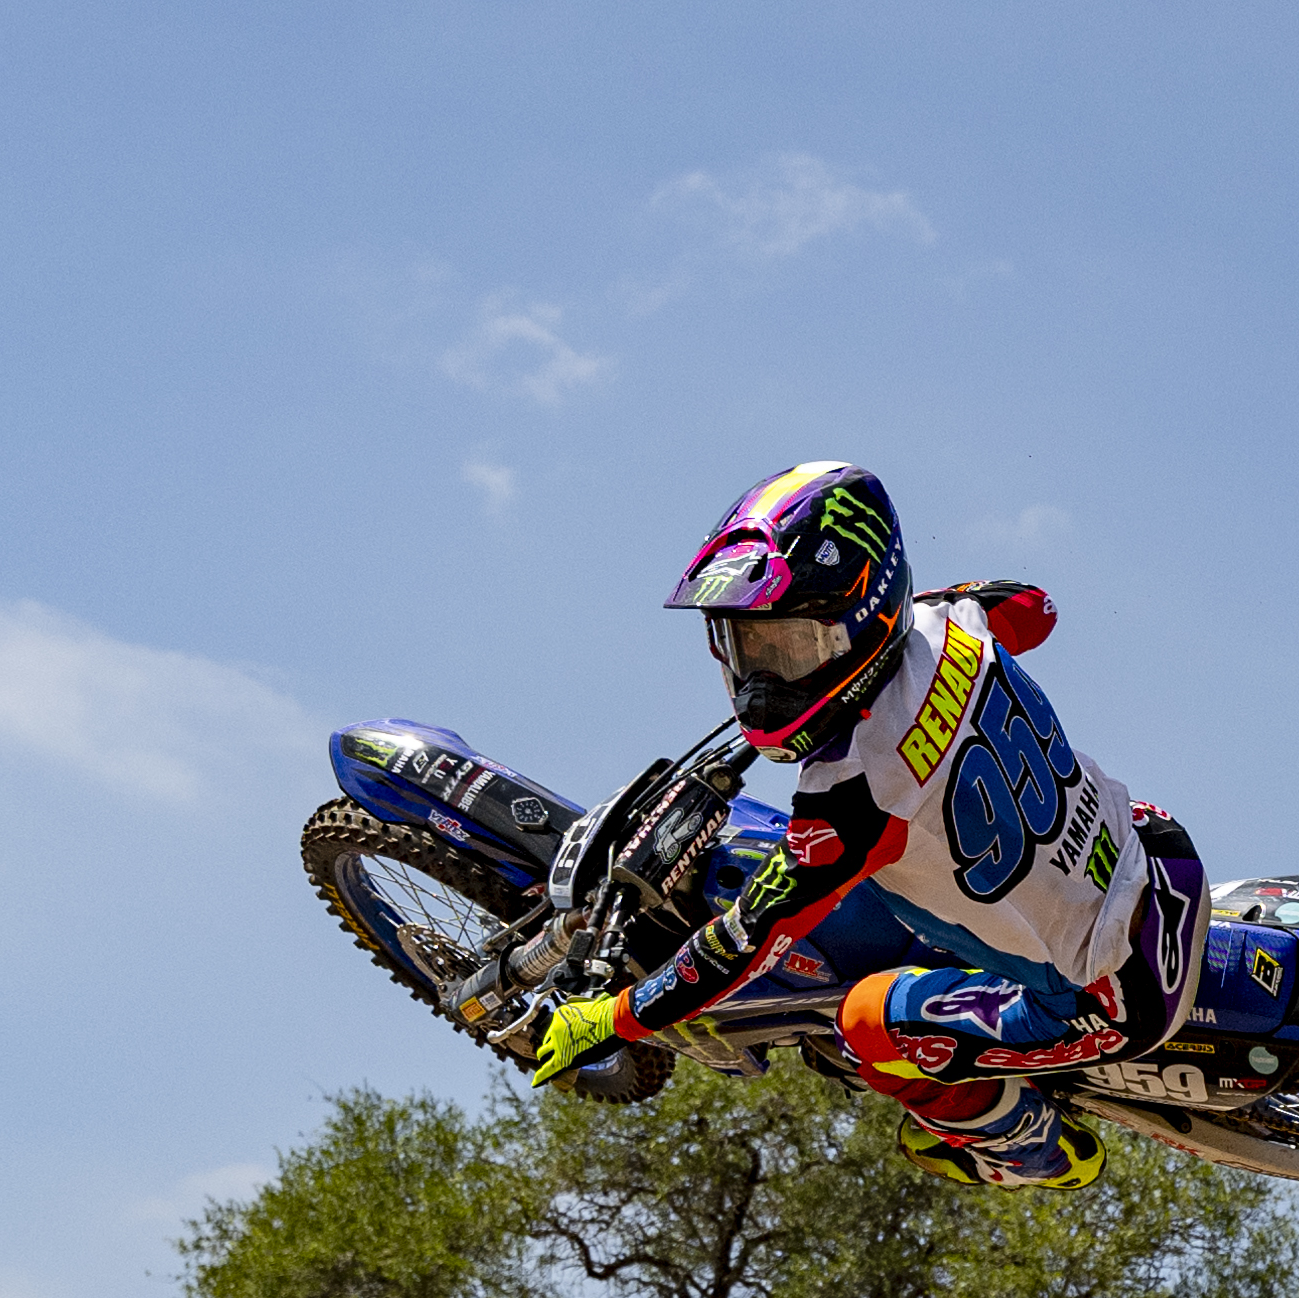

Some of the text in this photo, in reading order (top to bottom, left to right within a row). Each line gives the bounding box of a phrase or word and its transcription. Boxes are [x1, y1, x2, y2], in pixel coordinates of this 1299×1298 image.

[855, 537, 903, 623] OAKLEY
[899, 619, 984, 785] RENAUX
[457, 770, 497, 813] YAMALUBE
[943, 639, 1083, 904] 959
[661, 808, 728, 896] RENTHAL
[1049, 772, 1101, 877] YAMAHA
[1082, 1063, 1209, 1103] 959
